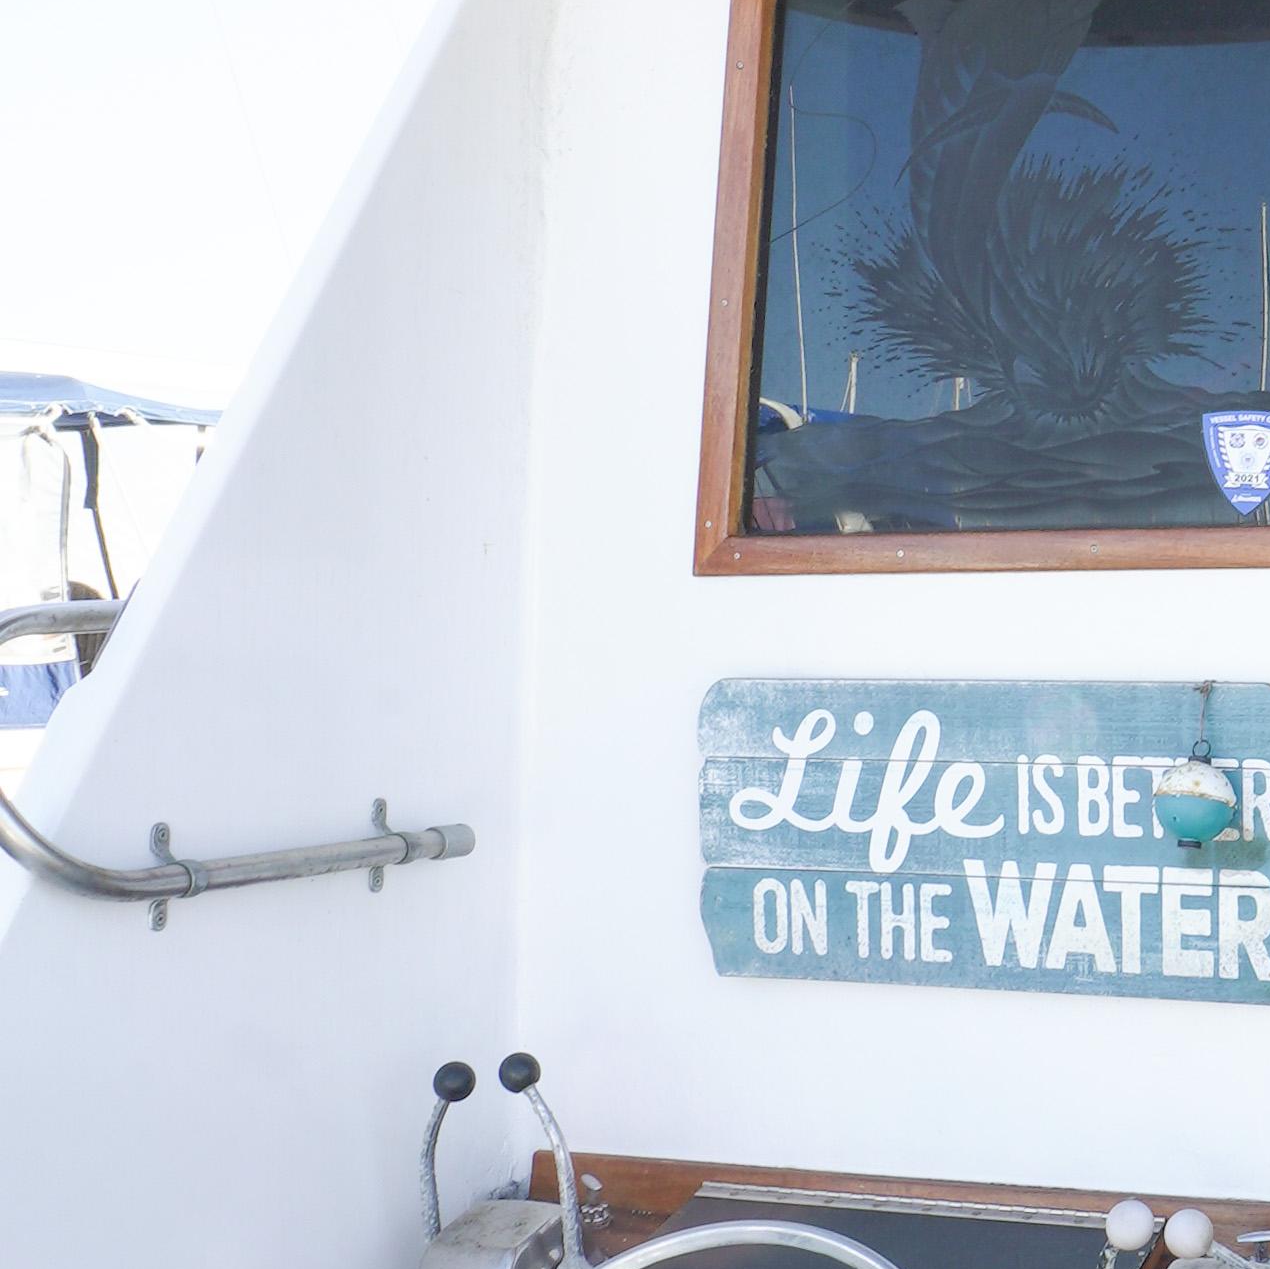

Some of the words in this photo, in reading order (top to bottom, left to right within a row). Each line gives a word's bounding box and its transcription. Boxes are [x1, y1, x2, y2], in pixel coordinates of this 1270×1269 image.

[1210, 414, 1237, 424] VESSEL
[1238, 413, 1266, 423] SAFETY
[1234, 473, 1259, 482] 2021
[729, 709, 1005, 873] Life
[1017, 753, 1065, 835] IS
[753, 877, 828, 956] ON
[845, 880, 953, 963] THE
